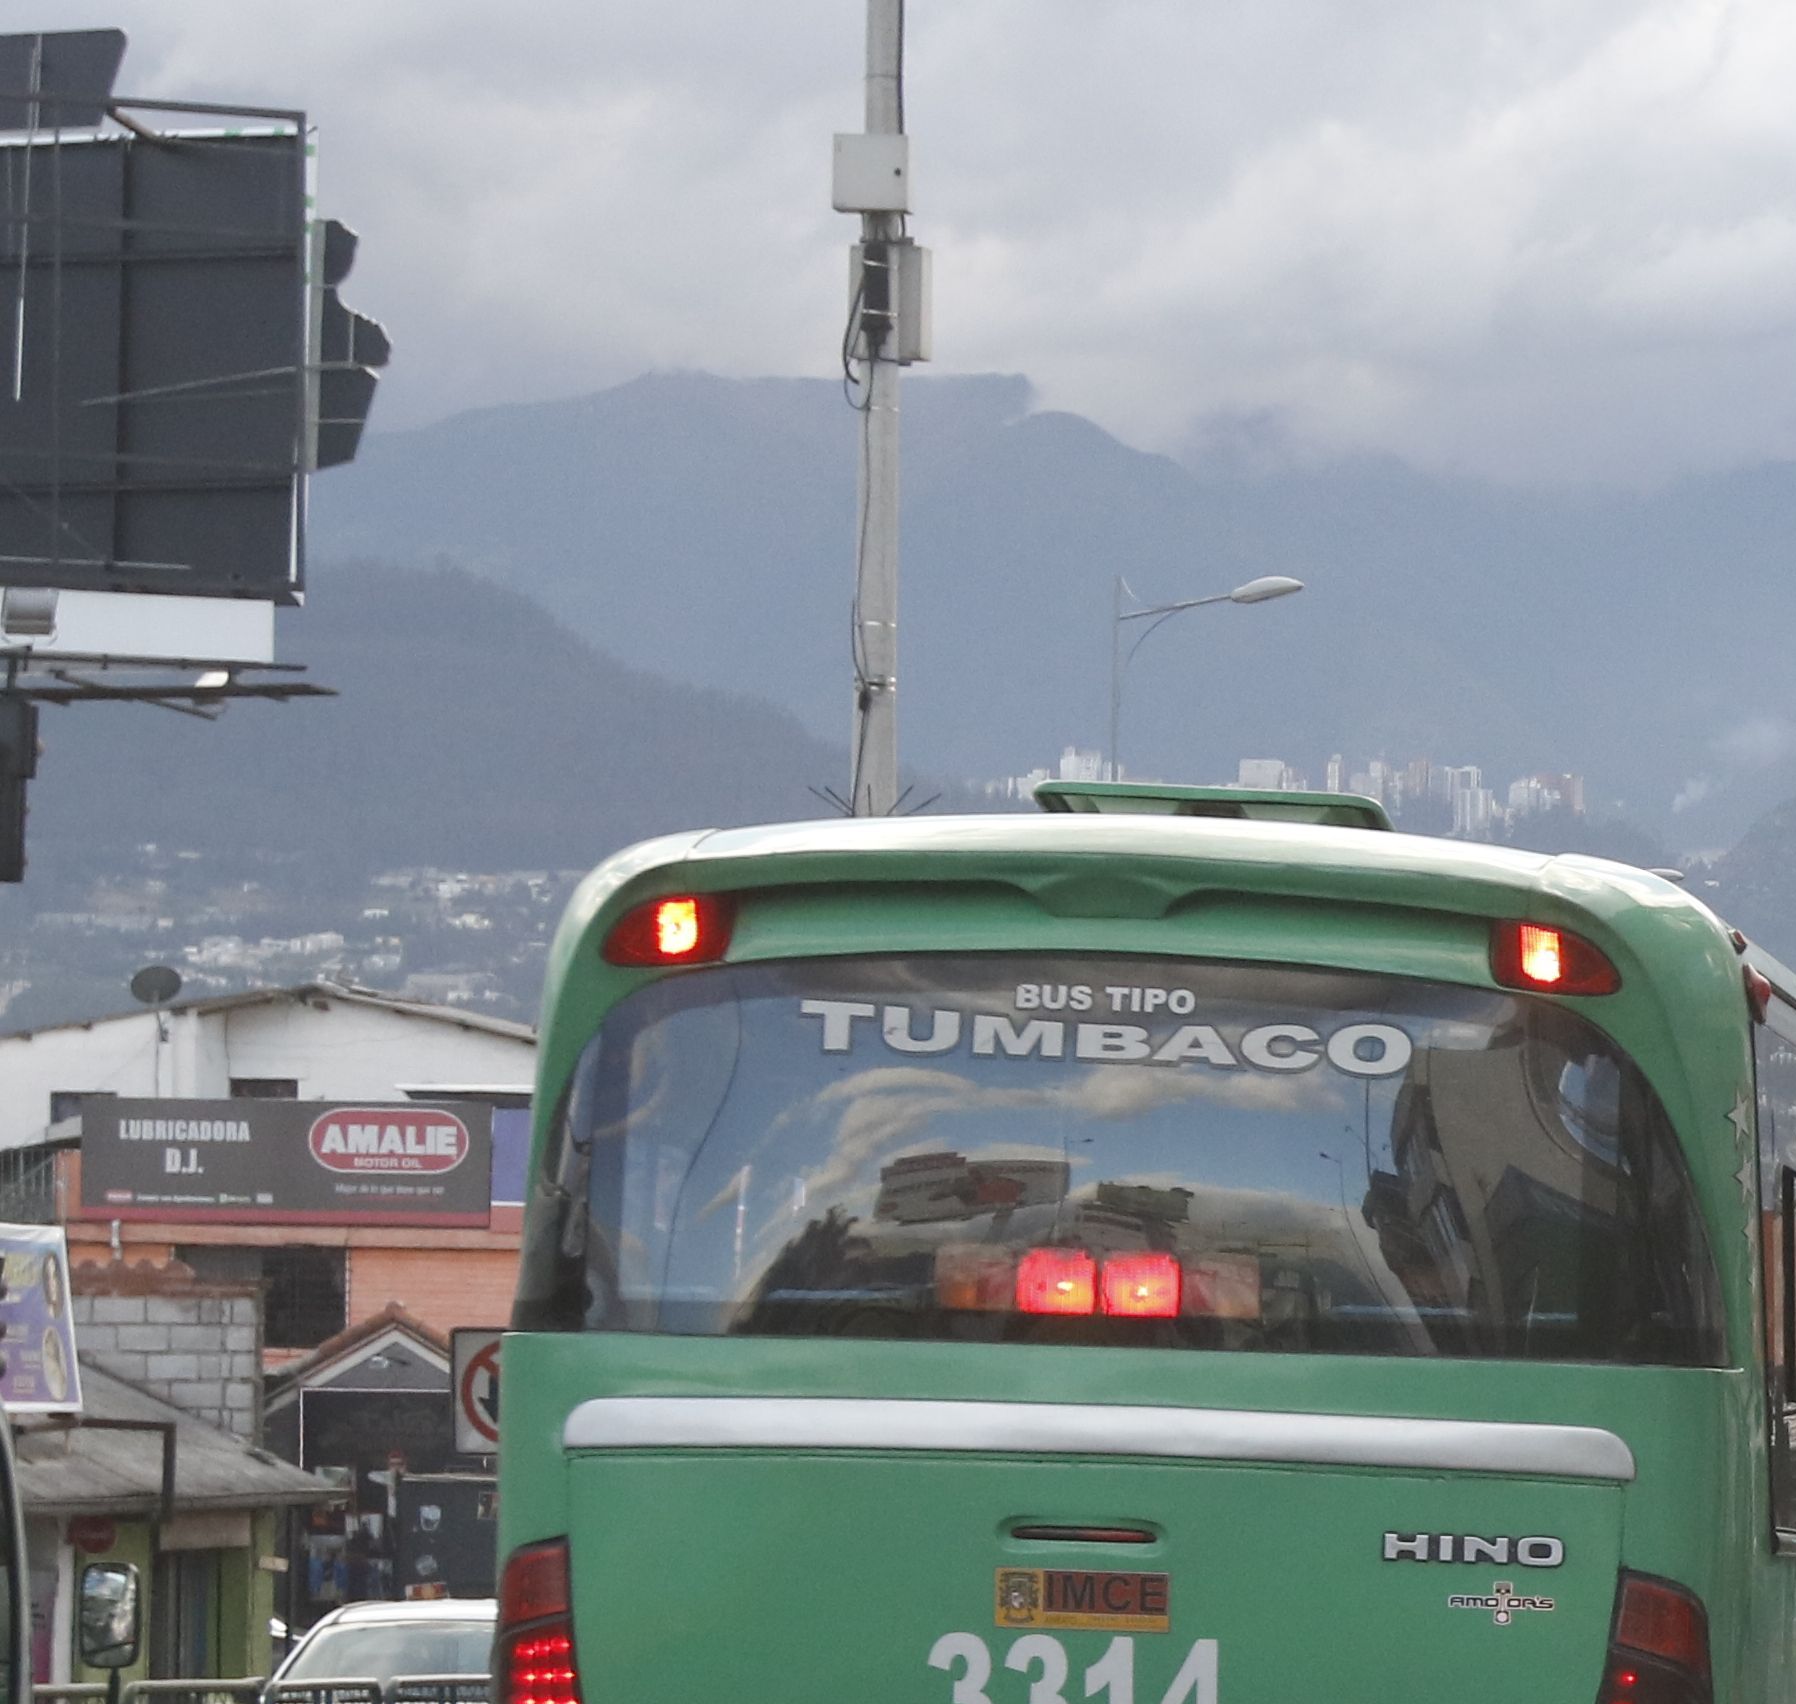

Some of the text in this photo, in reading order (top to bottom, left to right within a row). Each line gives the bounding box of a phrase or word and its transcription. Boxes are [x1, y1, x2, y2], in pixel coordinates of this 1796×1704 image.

[1015, 983, 1196, 1015] BUS TIPO
[800, 1000, 1414, 1077] TUMBACO
[119, 1118, 251, 1142] LUBRICADORA
[320, 1124, 459, 1156] AMALIE
[164, 1147, 204, 1174] D.J.
[353, 1156, 422, 1169] MOTOR OIL
[1383, 1532, 1565, 1567] HINO
